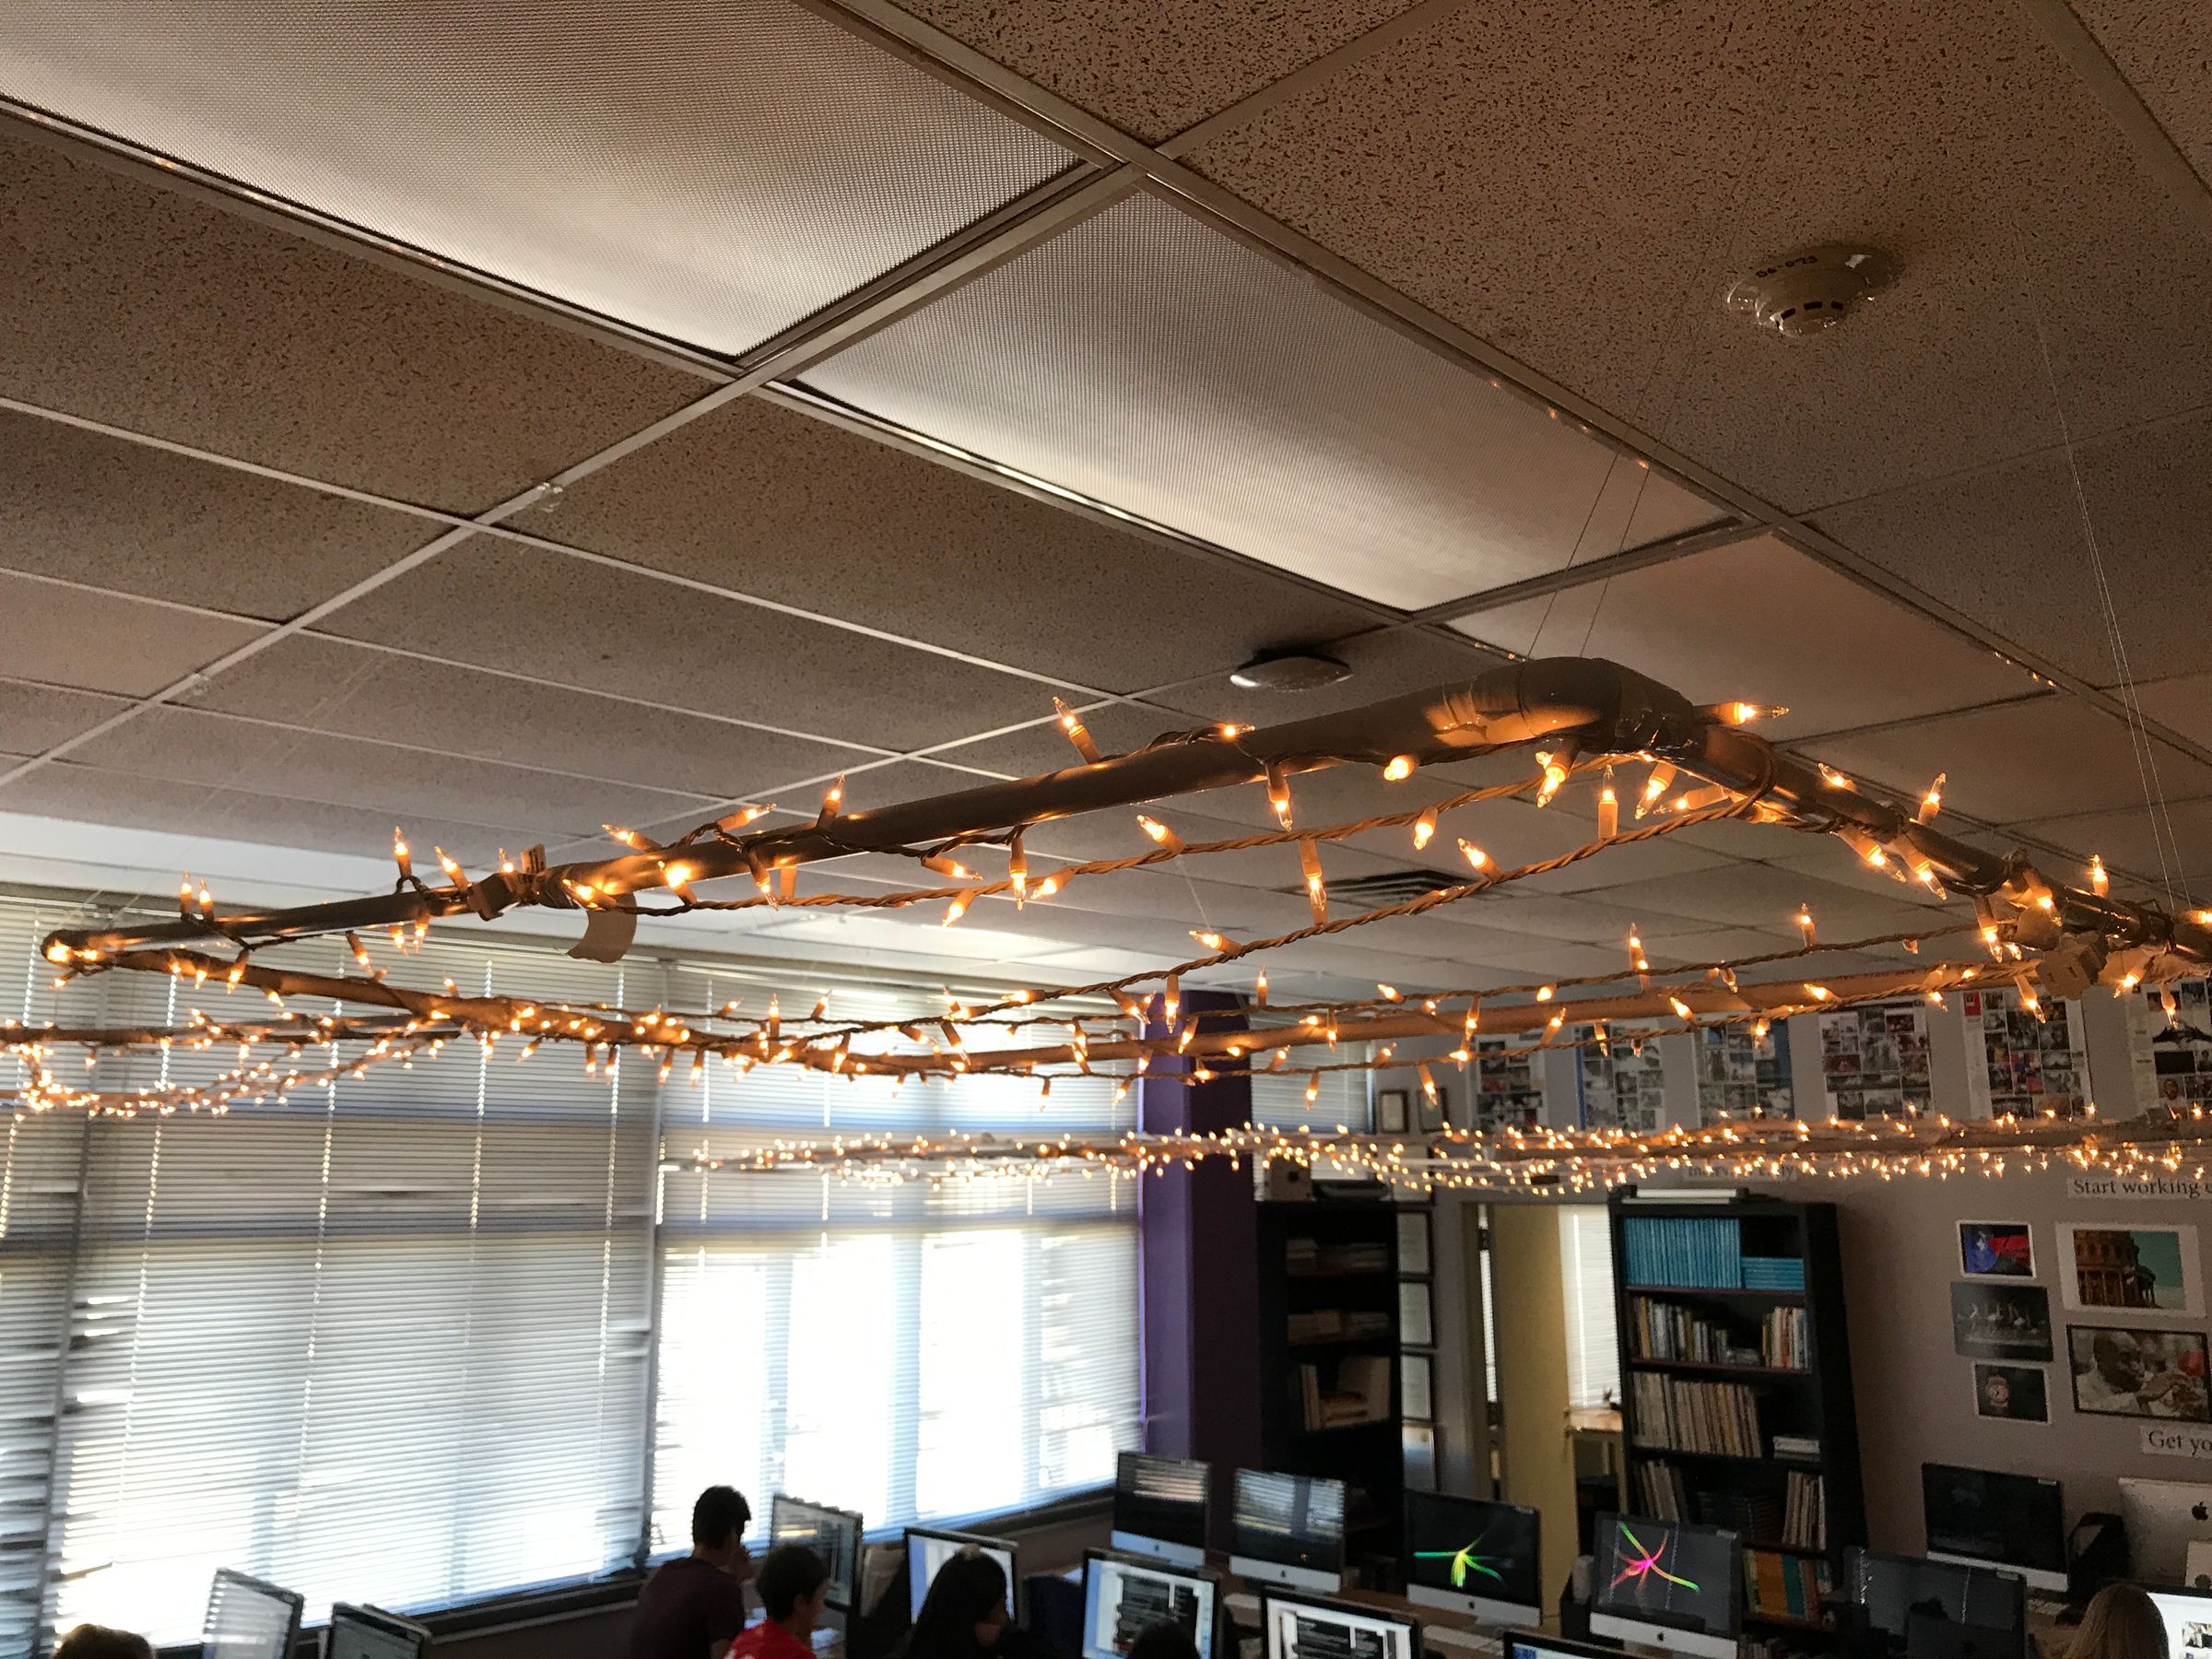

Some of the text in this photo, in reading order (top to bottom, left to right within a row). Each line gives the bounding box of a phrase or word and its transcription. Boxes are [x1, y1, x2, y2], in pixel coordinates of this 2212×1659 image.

[2074, 1179, 2116, 1194] Start
[2123, 1178, 2201, 1199] working
[2148, 1430, 2183, 1449] Get
